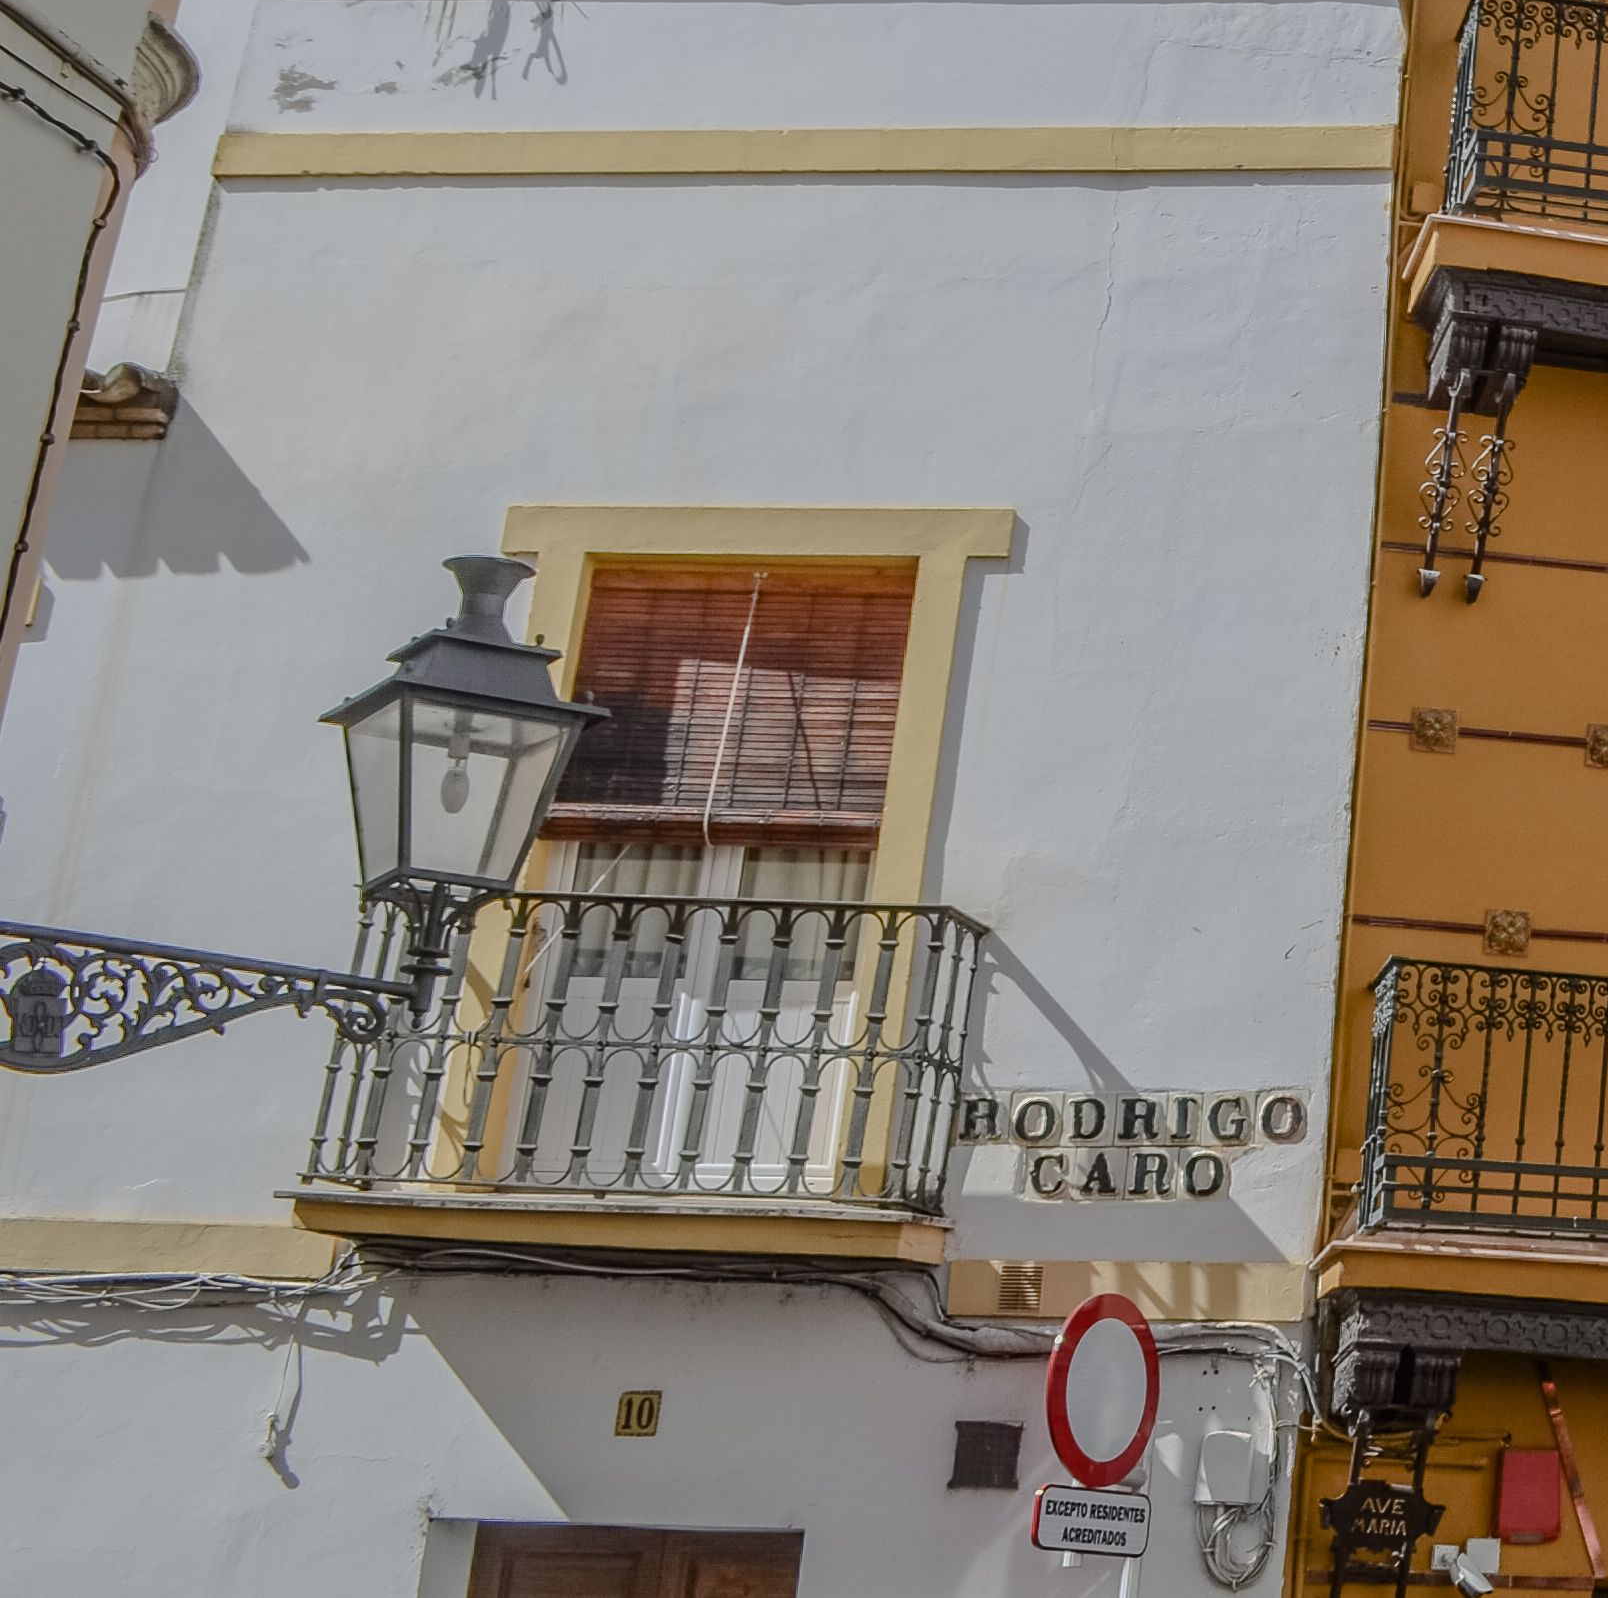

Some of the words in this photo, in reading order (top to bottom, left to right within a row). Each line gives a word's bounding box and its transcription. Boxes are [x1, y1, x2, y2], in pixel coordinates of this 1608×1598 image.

[959, 1096, 1307, 1144] RODRIGO
[1029, 1152, 1224, 1196] CARO
[620, 1396, 655, 1430] 10
[1045, 1499, 1088, 1519] EXCEPTO
[1089, 1503, 1146, 1524] RESIDENTES
[1359, 1497, 1405, 1515] AVE
[1061, 1526, 1128, 1547] ACREDITADOS
[1350, 1517, 1407, 1536] MARIA
